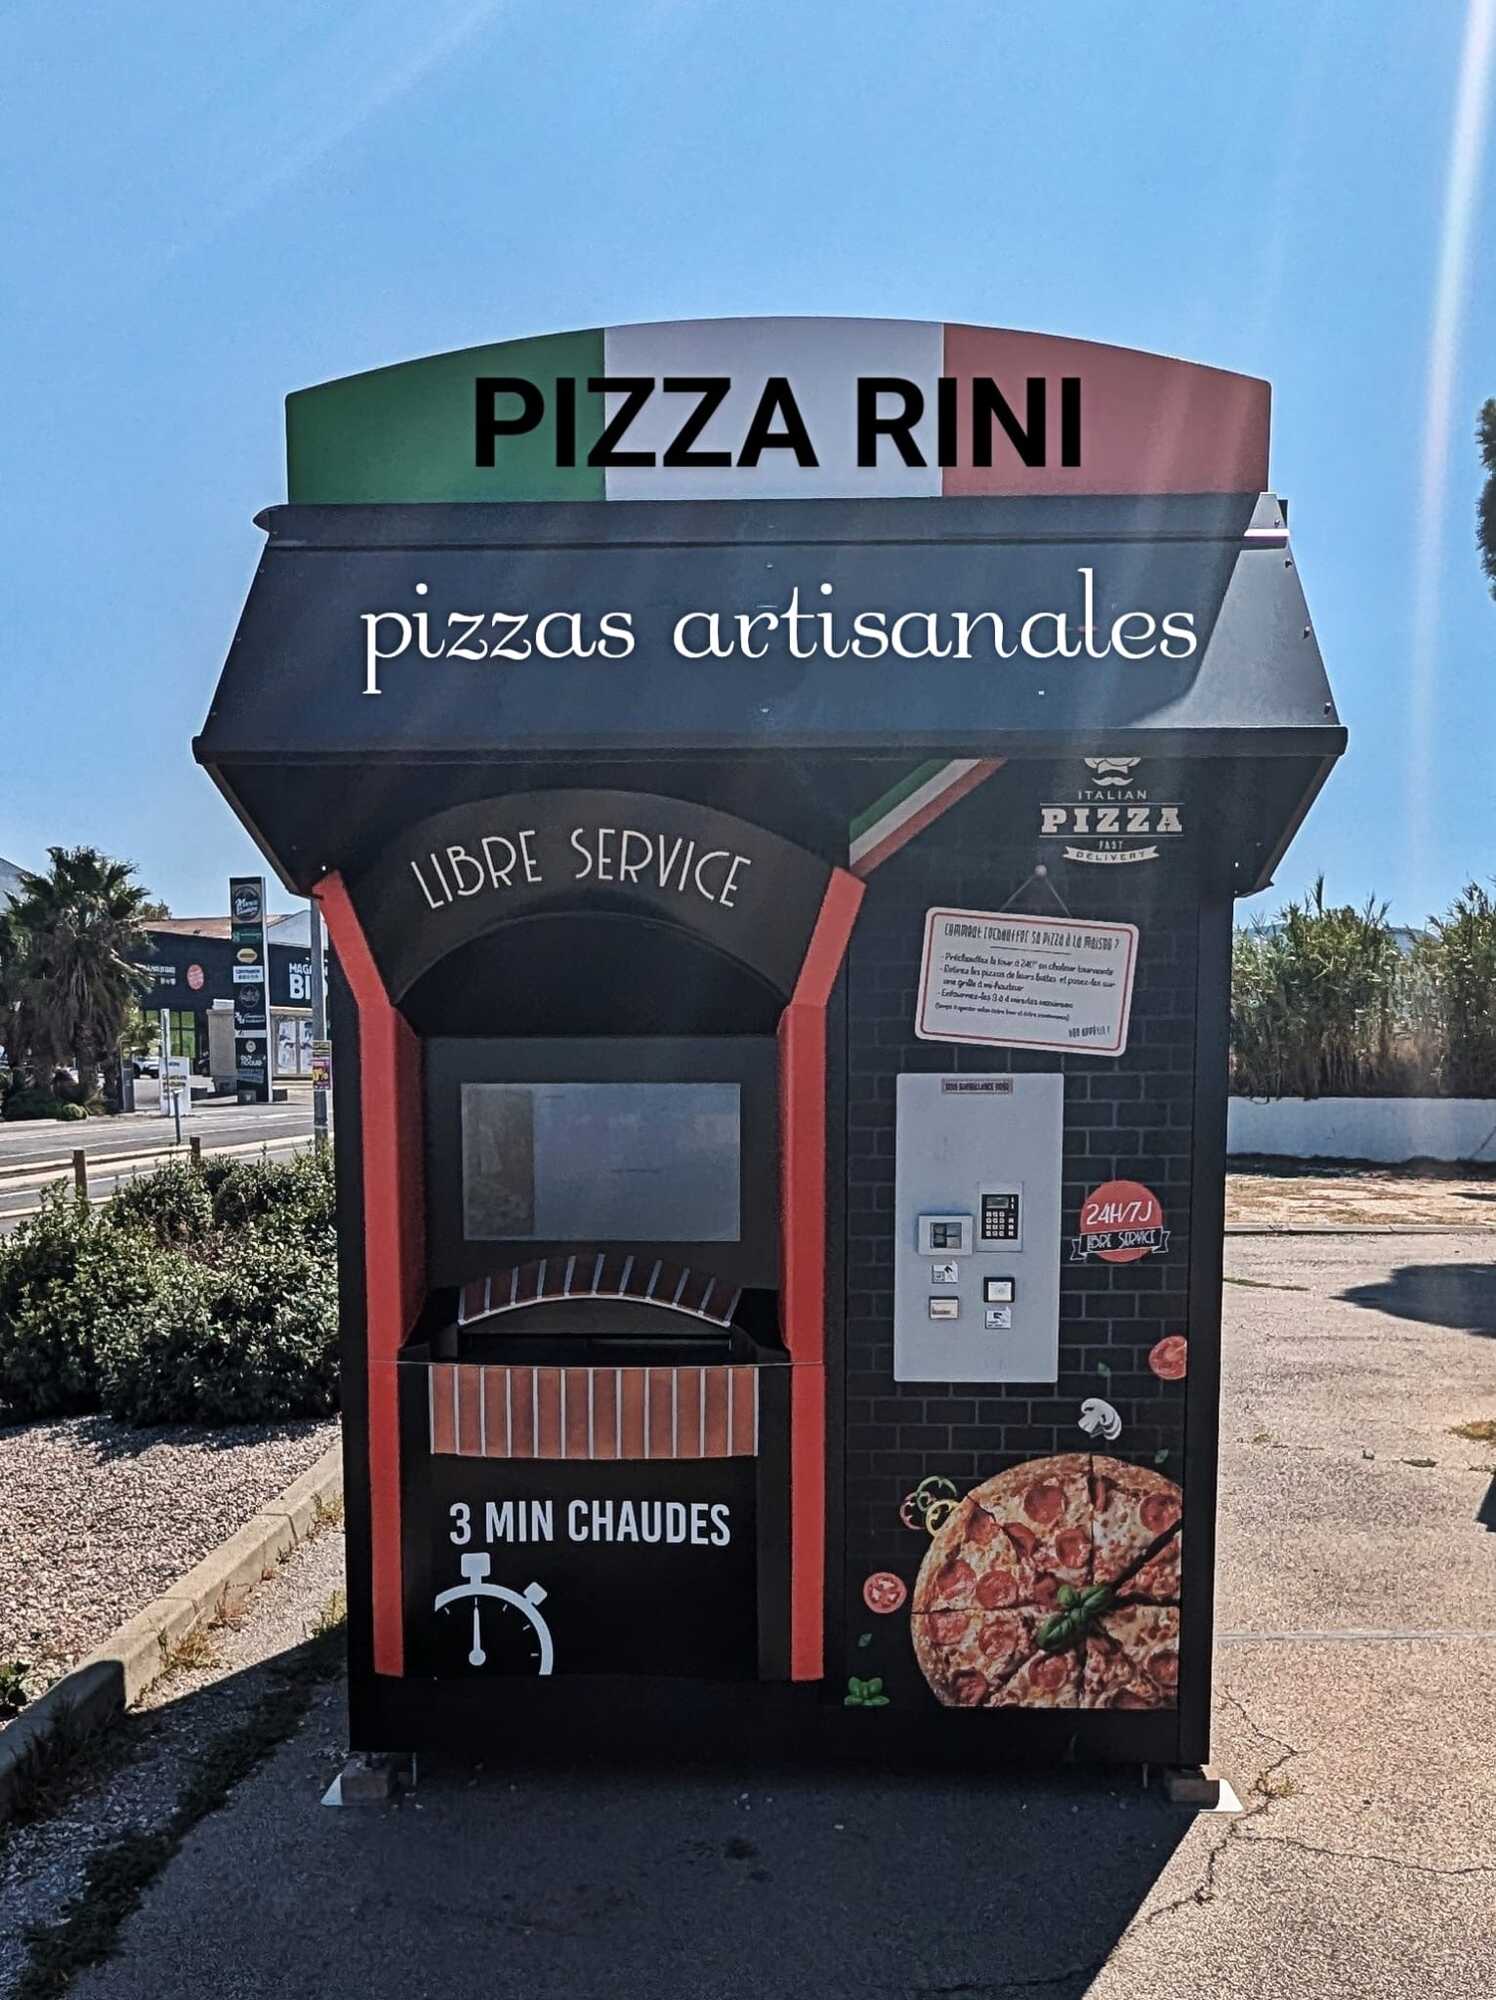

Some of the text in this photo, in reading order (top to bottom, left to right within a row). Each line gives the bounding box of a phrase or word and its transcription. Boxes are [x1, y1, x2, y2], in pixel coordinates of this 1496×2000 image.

[474, 376, 1082, 468] PIZZA RINI
[361, 567, 1198, 695] pizzas artisanales
[1078, 790, 1148, 800] ITALIAN
[1041, 807, 1183, 833] PIZZA
[1075, 851, 1145, 862] DELIVERY
[1099, 841, 1123, 850] FAST
[411, 828, 752, 909] LIBRE SERVICE
[1086, 1200, 1153, 1226] 24H/7J
[450, 1500, 731, 1547] 3 MIN CHAUDES
